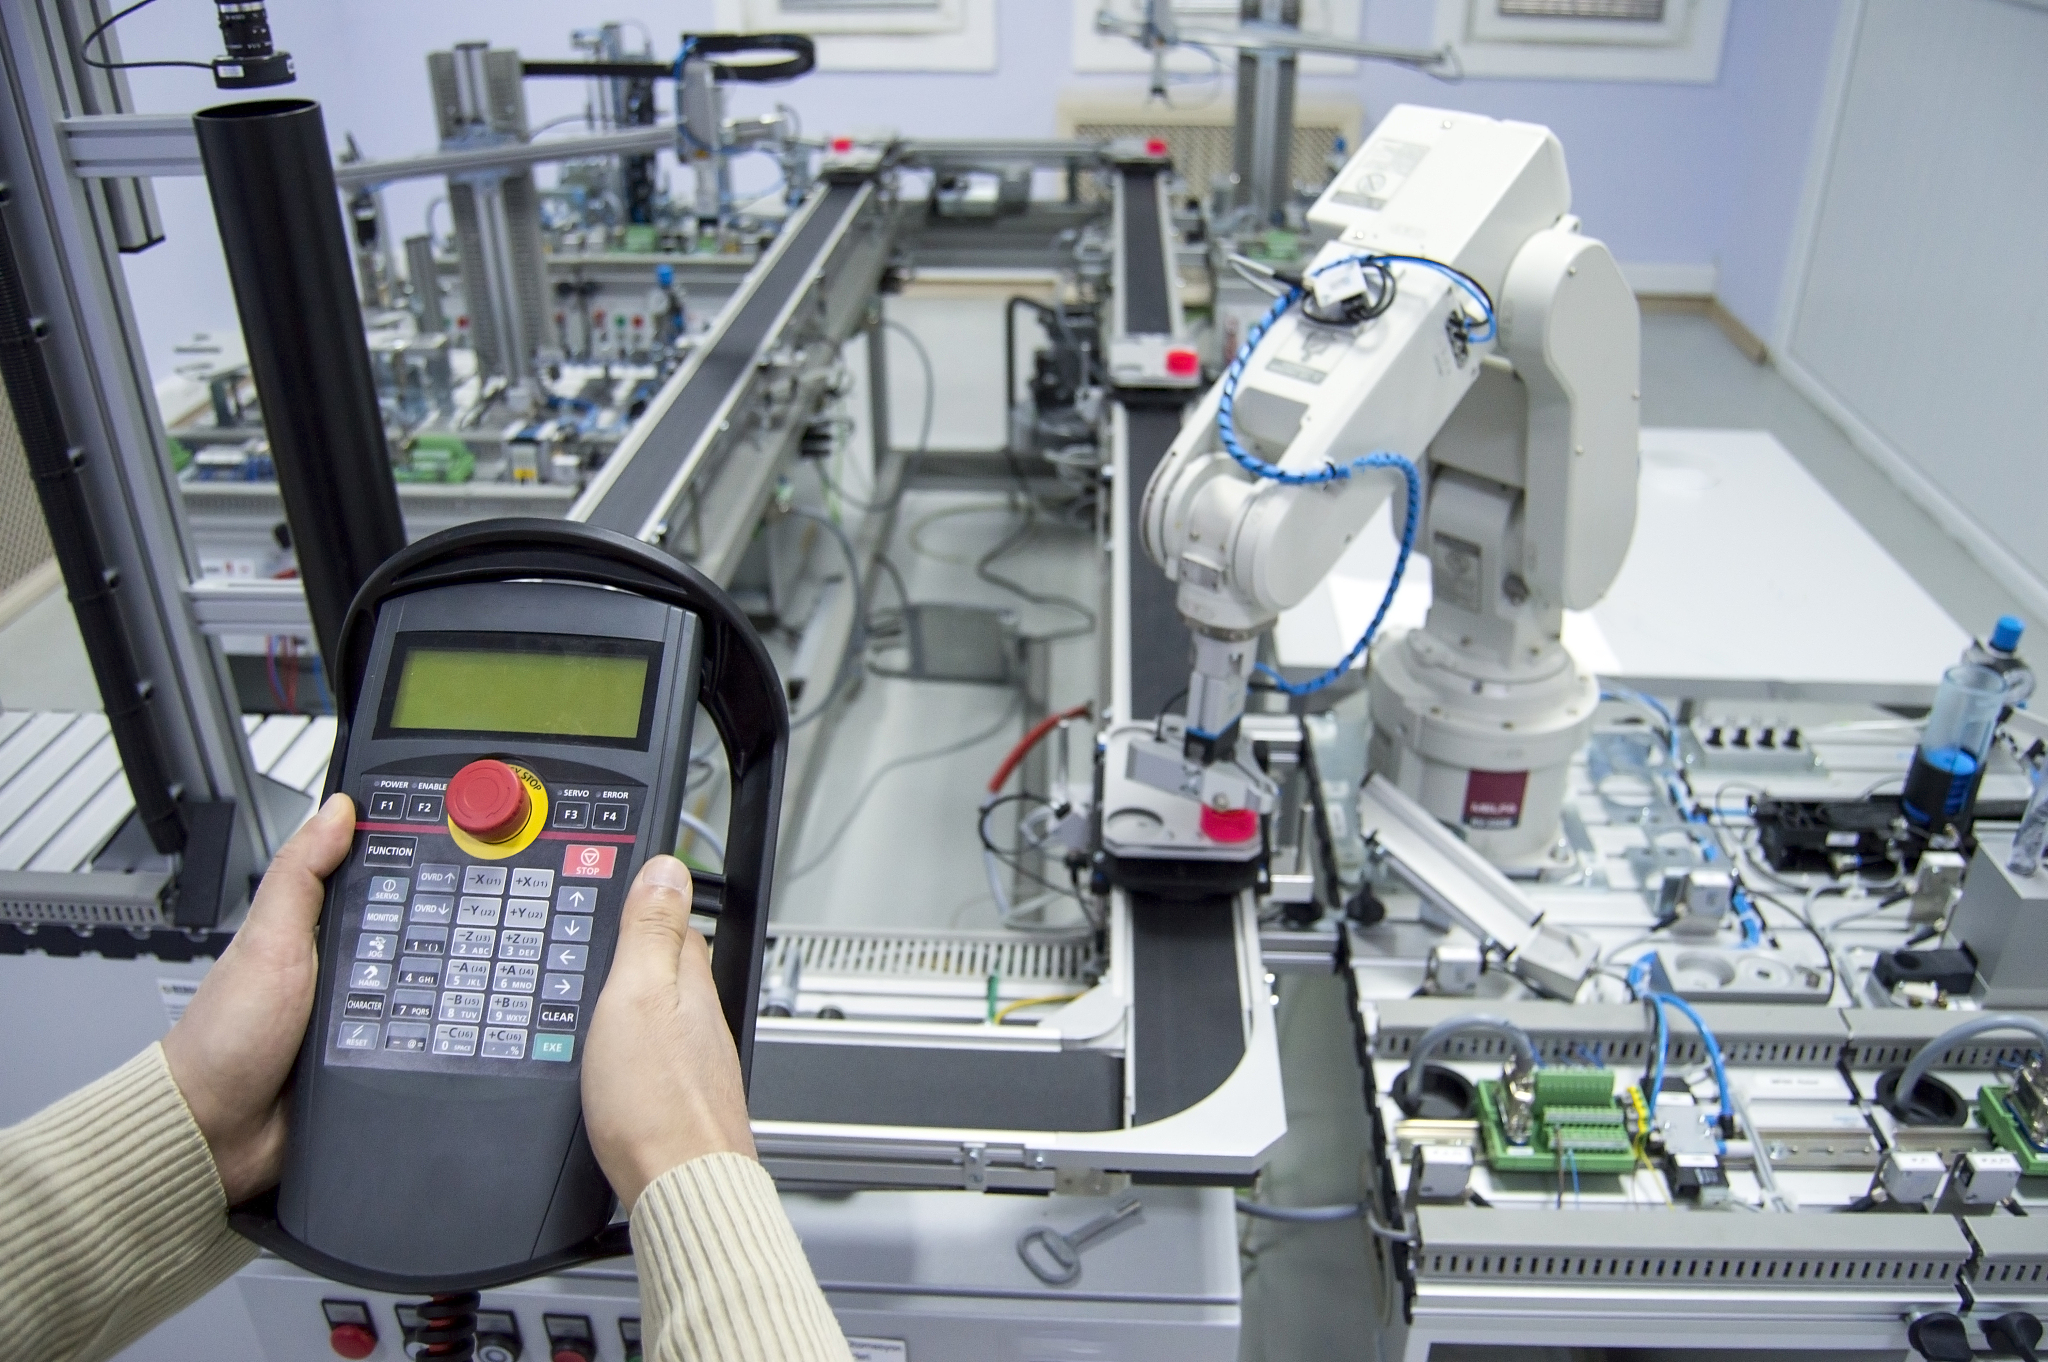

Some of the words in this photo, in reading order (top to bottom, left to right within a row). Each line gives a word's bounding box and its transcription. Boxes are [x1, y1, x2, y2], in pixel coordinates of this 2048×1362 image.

[381, 781, 409, 789] POWER
[521, 771, 542, 791] STOP
[418, 782, 448, 791] ENABLE
[564, 789, 589, 798] SERVO
[603, 791, 629, 799] ERROR
[381, 801, 394, 810] F1
[418, 803, 432, 813] F2
[565, 810, 578, 819] F3
[603, 812, 617, 821] F4
[368, 845, 413, 857] FUNCTION
[576, 866, 600, 875] STOP
[421, 872, 443, 881] OVRD
[375, 892, 399, 900] SERVO
[414, 904, 437, 913] OVRD
[367, 913, 399, 923] MONITOR
[413, 941, 419, 951] 1
[459, 944, 467, 954] 2
[472, 946, 490, 955] ABC
[506, 946, 514, 956] 3
[518, 948, 535, 957] DEF
[358, 979, 380, 987] HAND
[405, 973, 413, 982] 4
[418, 976, 434, 984] GHI
[453, 976, 460, 986] 5
[466, 978, 482, 987] JKL
[500, 979, 508, 988] 6
[512, 981, 533, 989] MNO
[347, 1000, 382, 1010] CHARACTER
[399, 1005, 407, 1015] 7
[411, 1008, 430, 1016] PQRS
[447, 1008, 455, 1018] 8
[461, 1011, 478, 1019] TUV
[495, 1012, 503, 1021] 9
[506, 1014, 527, 1022] WXYZ
[541, 1011, 574, 1022] CLEAR
[346, 1039, 368, 1047] RESET
[441, 1041, 449, 1051] 0
[542, 1042, 563, 1053] EXE
